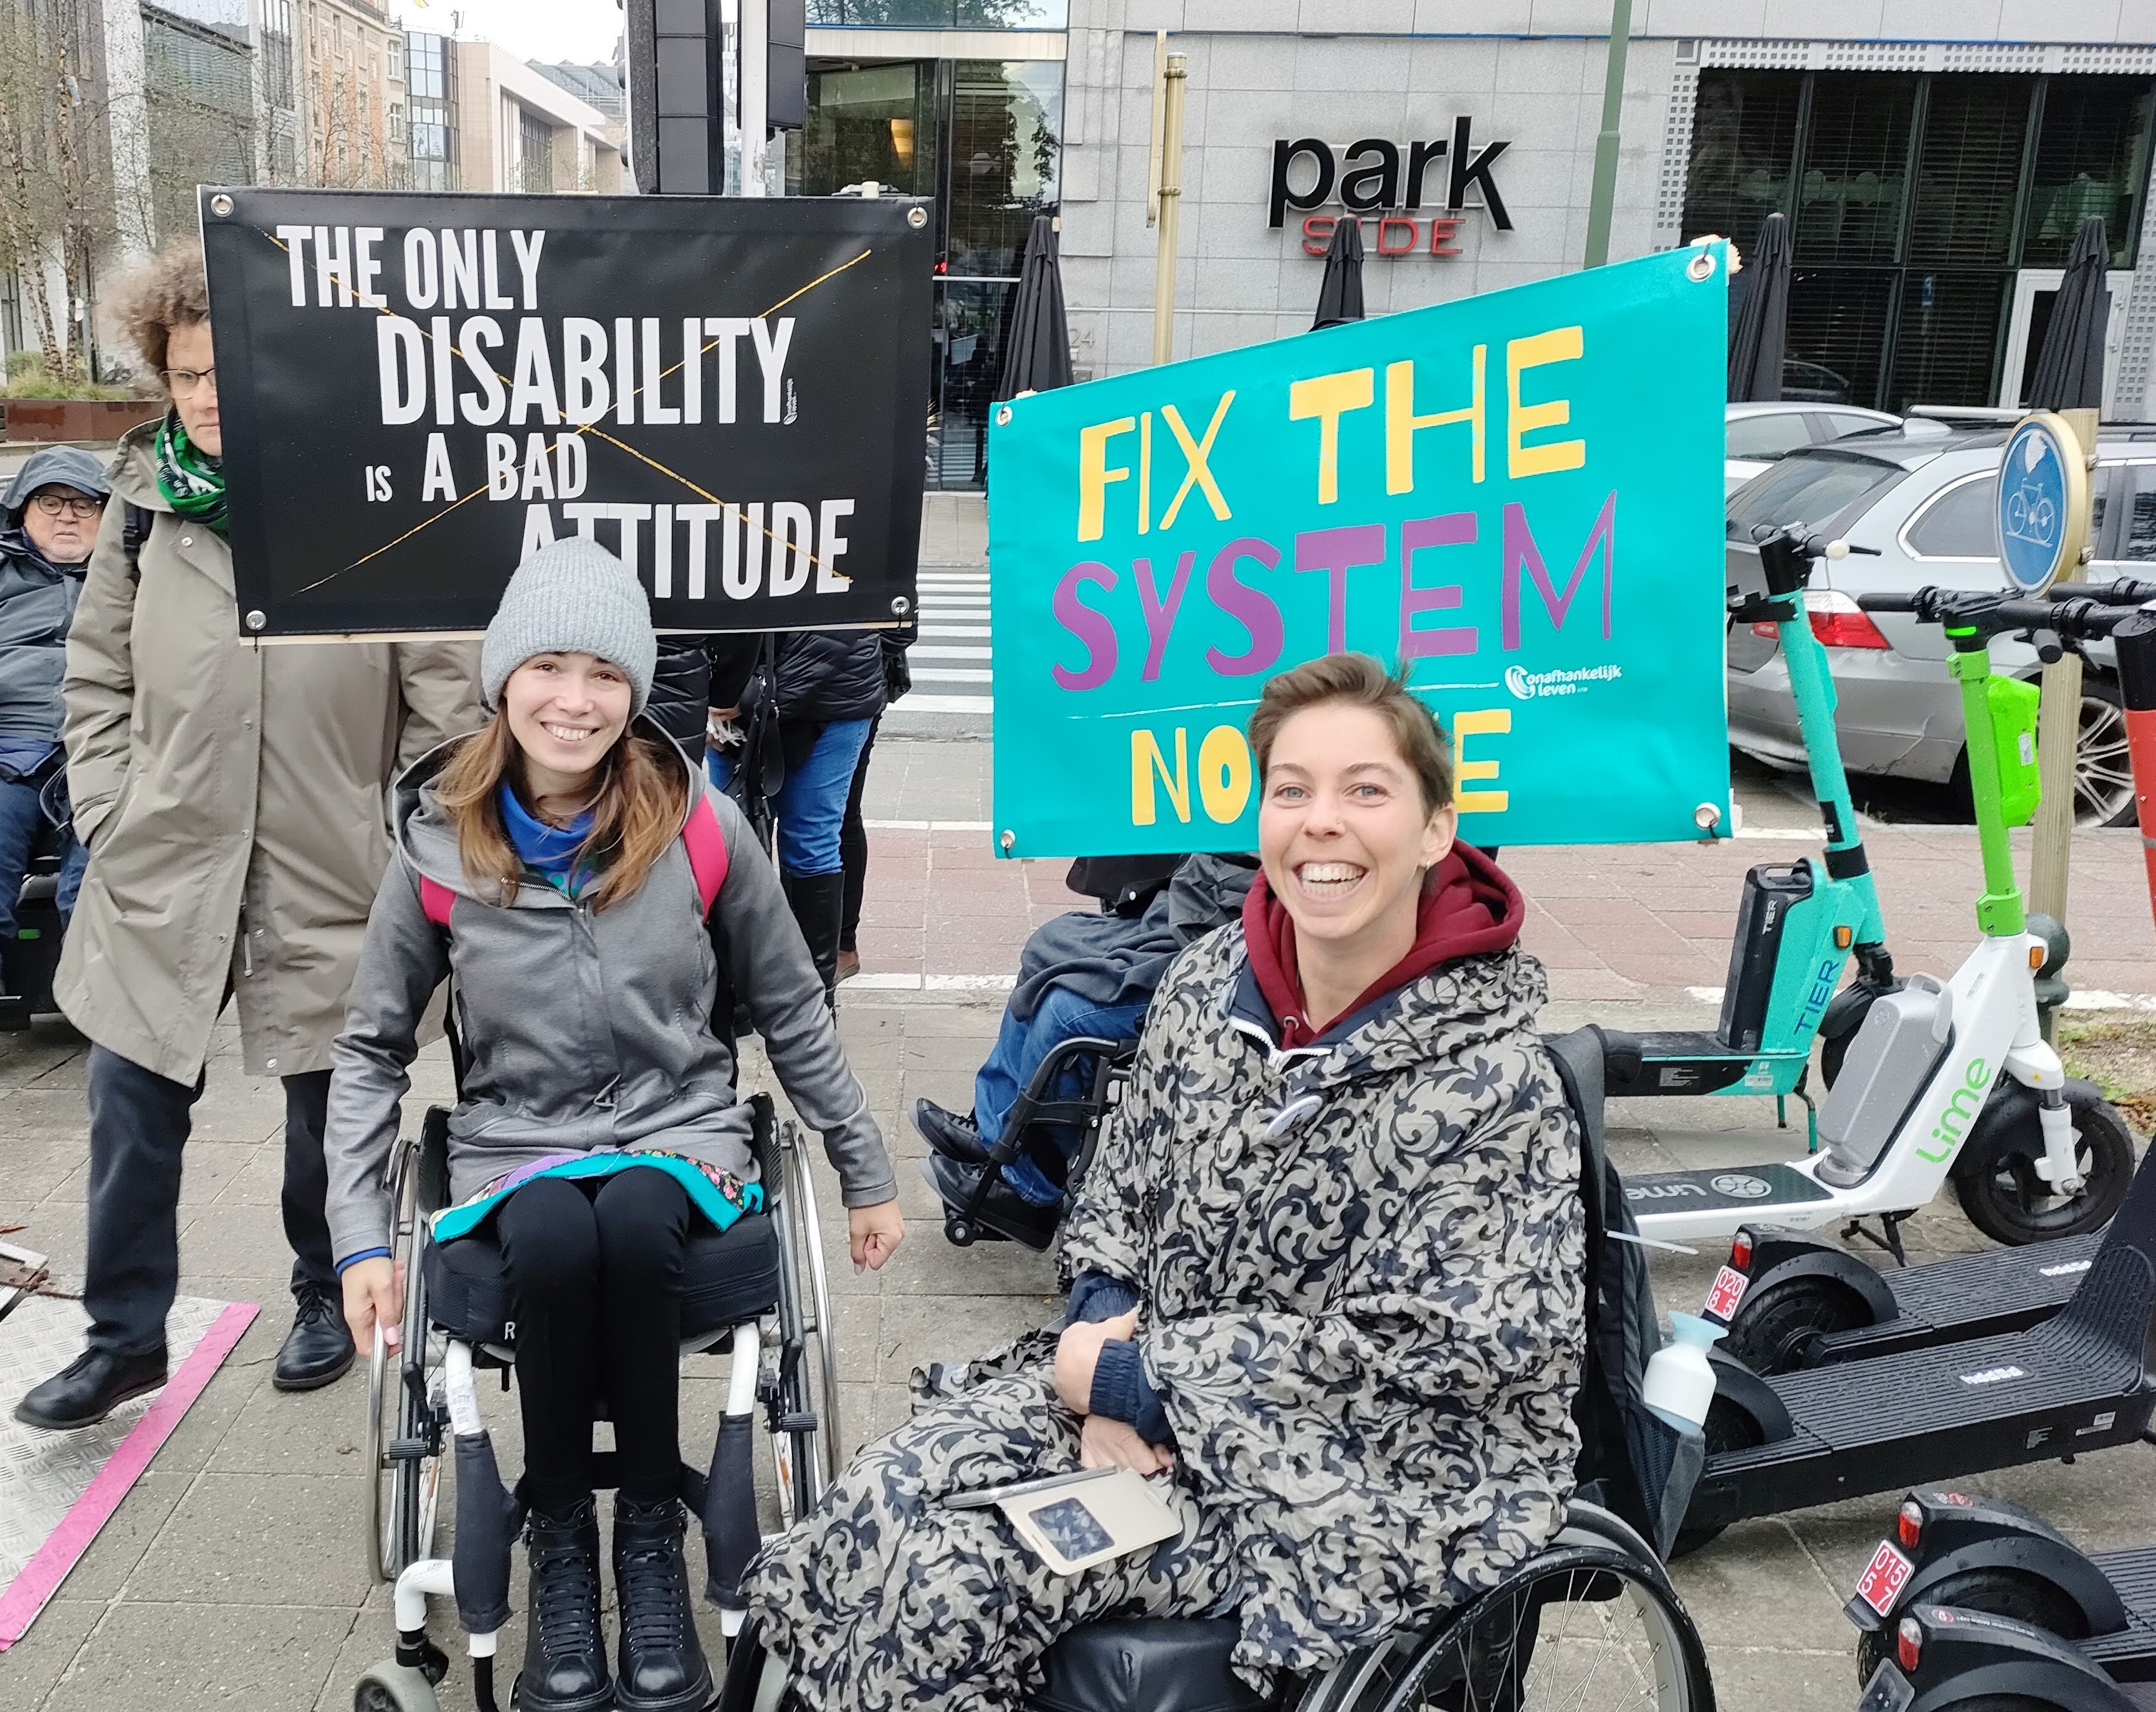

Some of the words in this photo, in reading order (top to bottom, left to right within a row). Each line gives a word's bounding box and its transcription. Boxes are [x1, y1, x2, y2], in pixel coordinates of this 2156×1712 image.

[1267, 115, 1514, 231] park
[275, 224, 388, 308] THE
[404, 226, 546, 310] ONLY
[1302, 216, 1466, 255] SDE
[376, 315, 796, 426] DISABILITY
[365, 465, 393, 502] IS
[422, 432, 458, 502] A
[485, 432, 588, 501] BAD
[1077, 390, 1236, 542] FIX
[1289, 325, 1586, 505] THE
[1051, 488, 1617, 692] SYSTEM
[1537, 683, 1576, 698] leven
[1762, 899, 1778, 936] TIER
[1793, 958, 1840, 1036] TIER
[1915, 1057, 1991, 1164] Lime
[1709, 1290, 1722, 1308] 8
[1722, 1297, 1736, 1316] 5
[1717, 1271, 1743, 1297] 020
[1861, 1571, 1878, 1594] 5
[1876, 1585, 1894, 1609] 7
[1875, 1548, 1907, 1587] 015
